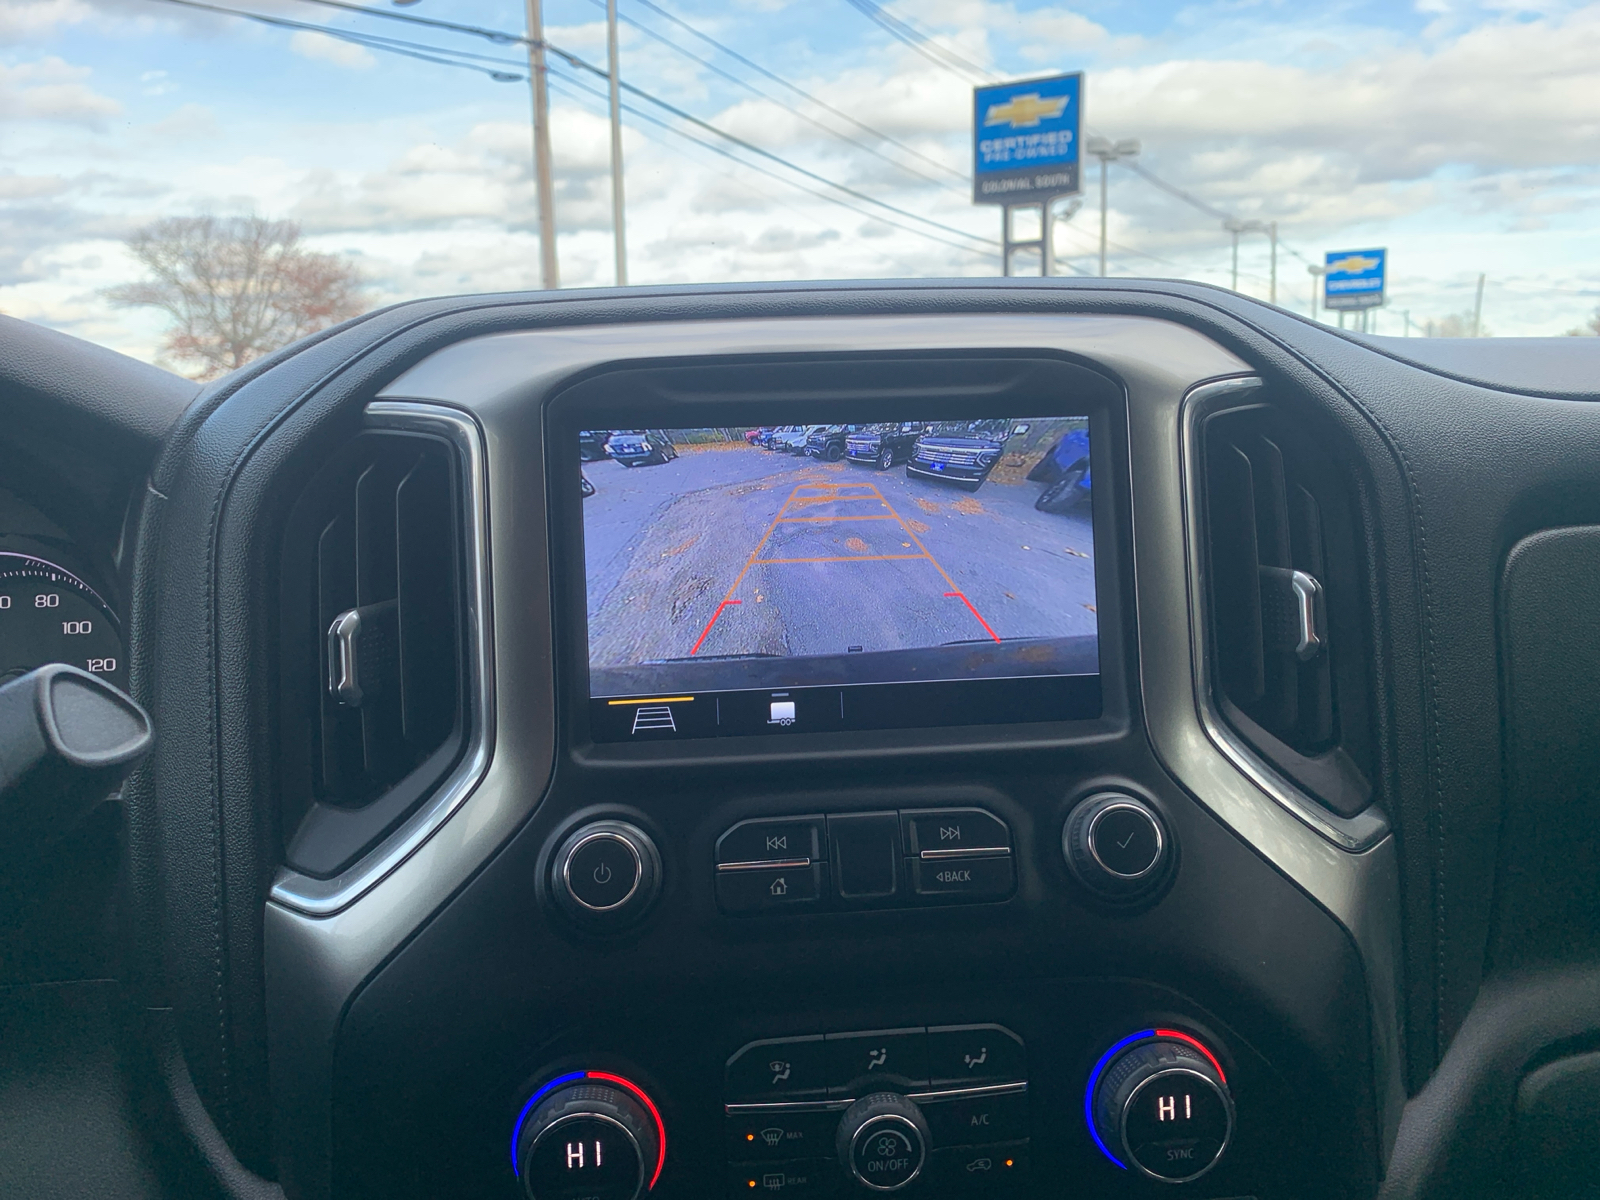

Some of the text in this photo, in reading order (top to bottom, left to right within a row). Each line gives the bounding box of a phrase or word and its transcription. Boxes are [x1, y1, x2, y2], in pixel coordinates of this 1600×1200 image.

[35, 594, 59, 608] 80
[62, 621, 92, 635] 100
[87, 658, 117, 672] 120
[944, 870, 971, 882] BACK
[1158, 1094, 1191, 1121] HI
[970, 1113, 990, 1127] A/C
[786, 1131, 804, 1140] MAX
[567, 1141, 601, 1169] HI
[1167, 1148, 1194, 1161] SYNC
[867, 1158, 909, 1172] ON/OFF
